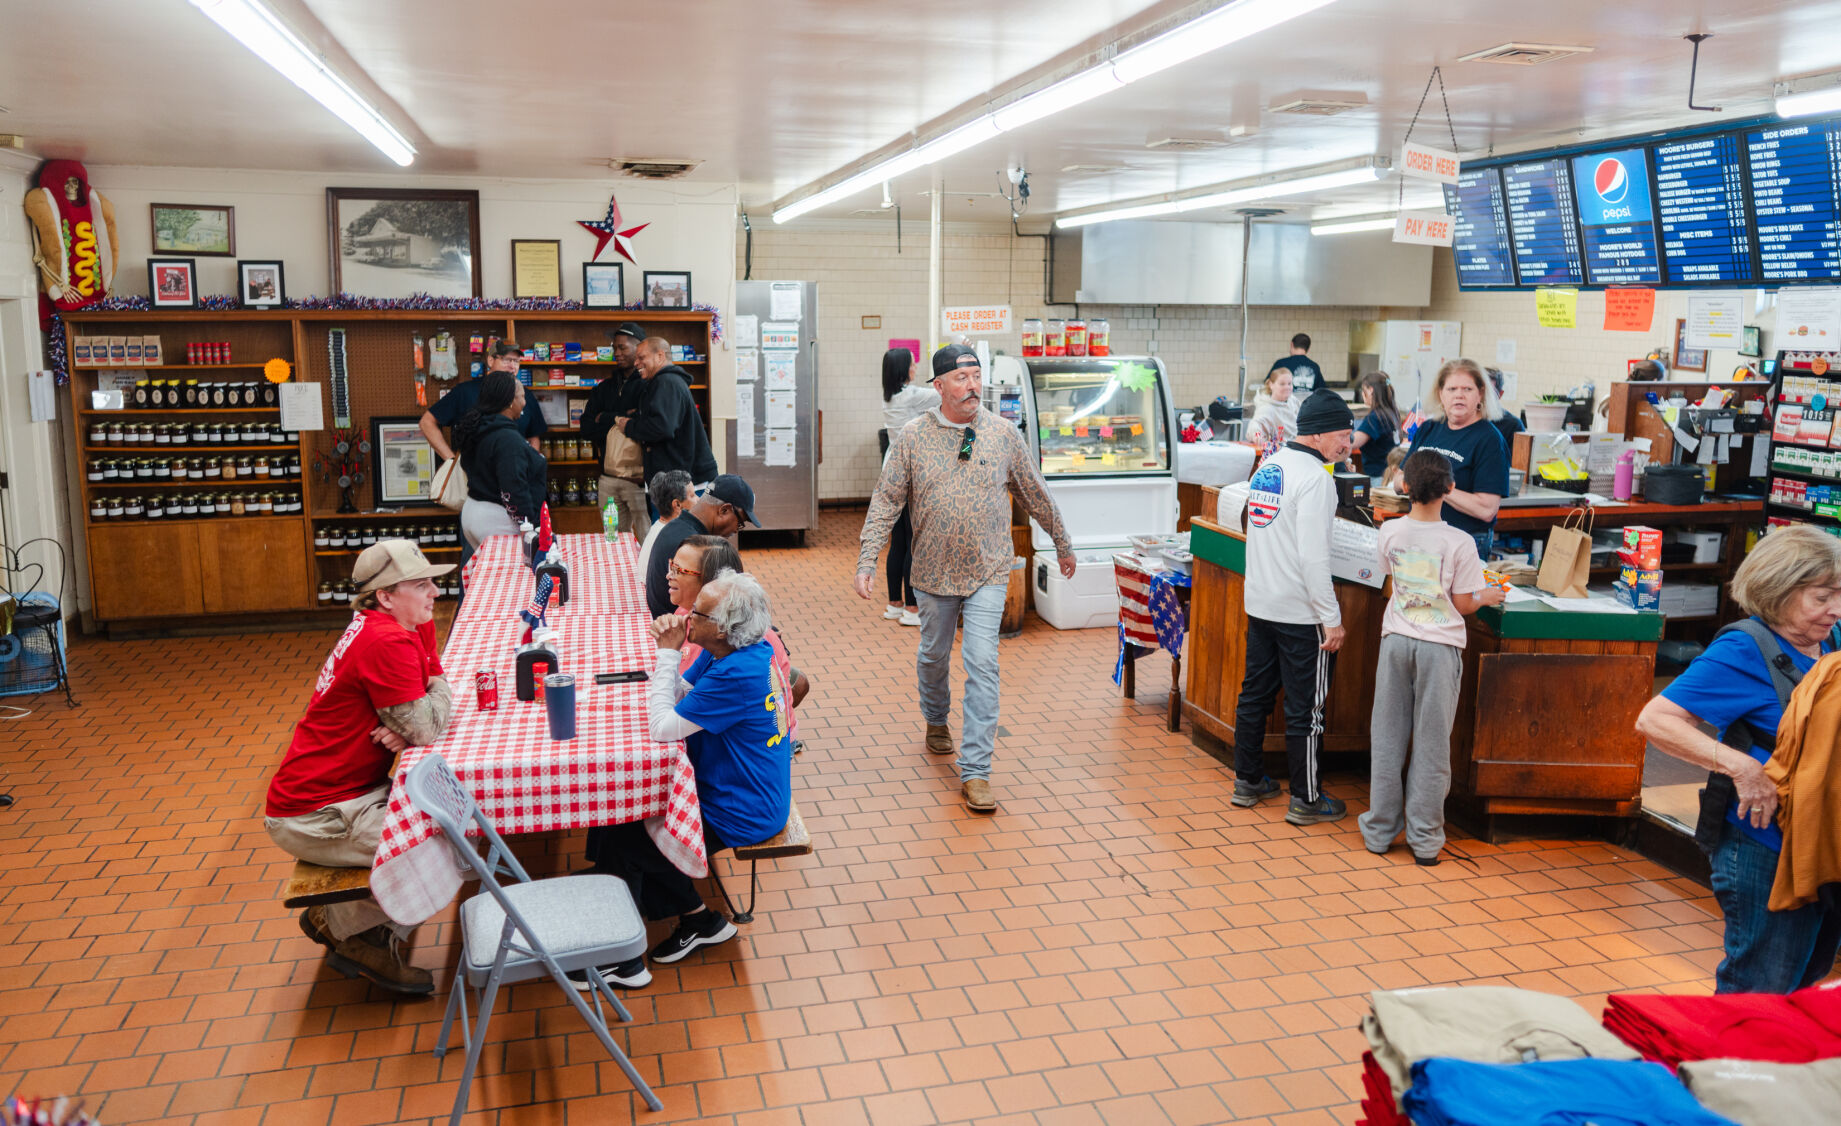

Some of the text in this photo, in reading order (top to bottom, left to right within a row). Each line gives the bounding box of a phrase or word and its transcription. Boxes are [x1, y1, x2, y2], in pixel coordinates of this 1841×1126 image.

[1762, 126, 1808, 140] SIDE ORDERS
[1659, 140, 1714, 154] MOORE'S BURGERS
[1406, 150, 1456, 176] ORDER HERE
[1602, 205, 1632, 220] pepsi
[1405, 218, 1448, 238] PAY HERE
[1605, 227, 1632, 235] WELCOME
[946, 310, 1007, 320] PLEASE ORDER AT
[951, 321, 1003, 332] CASH REGISTER
